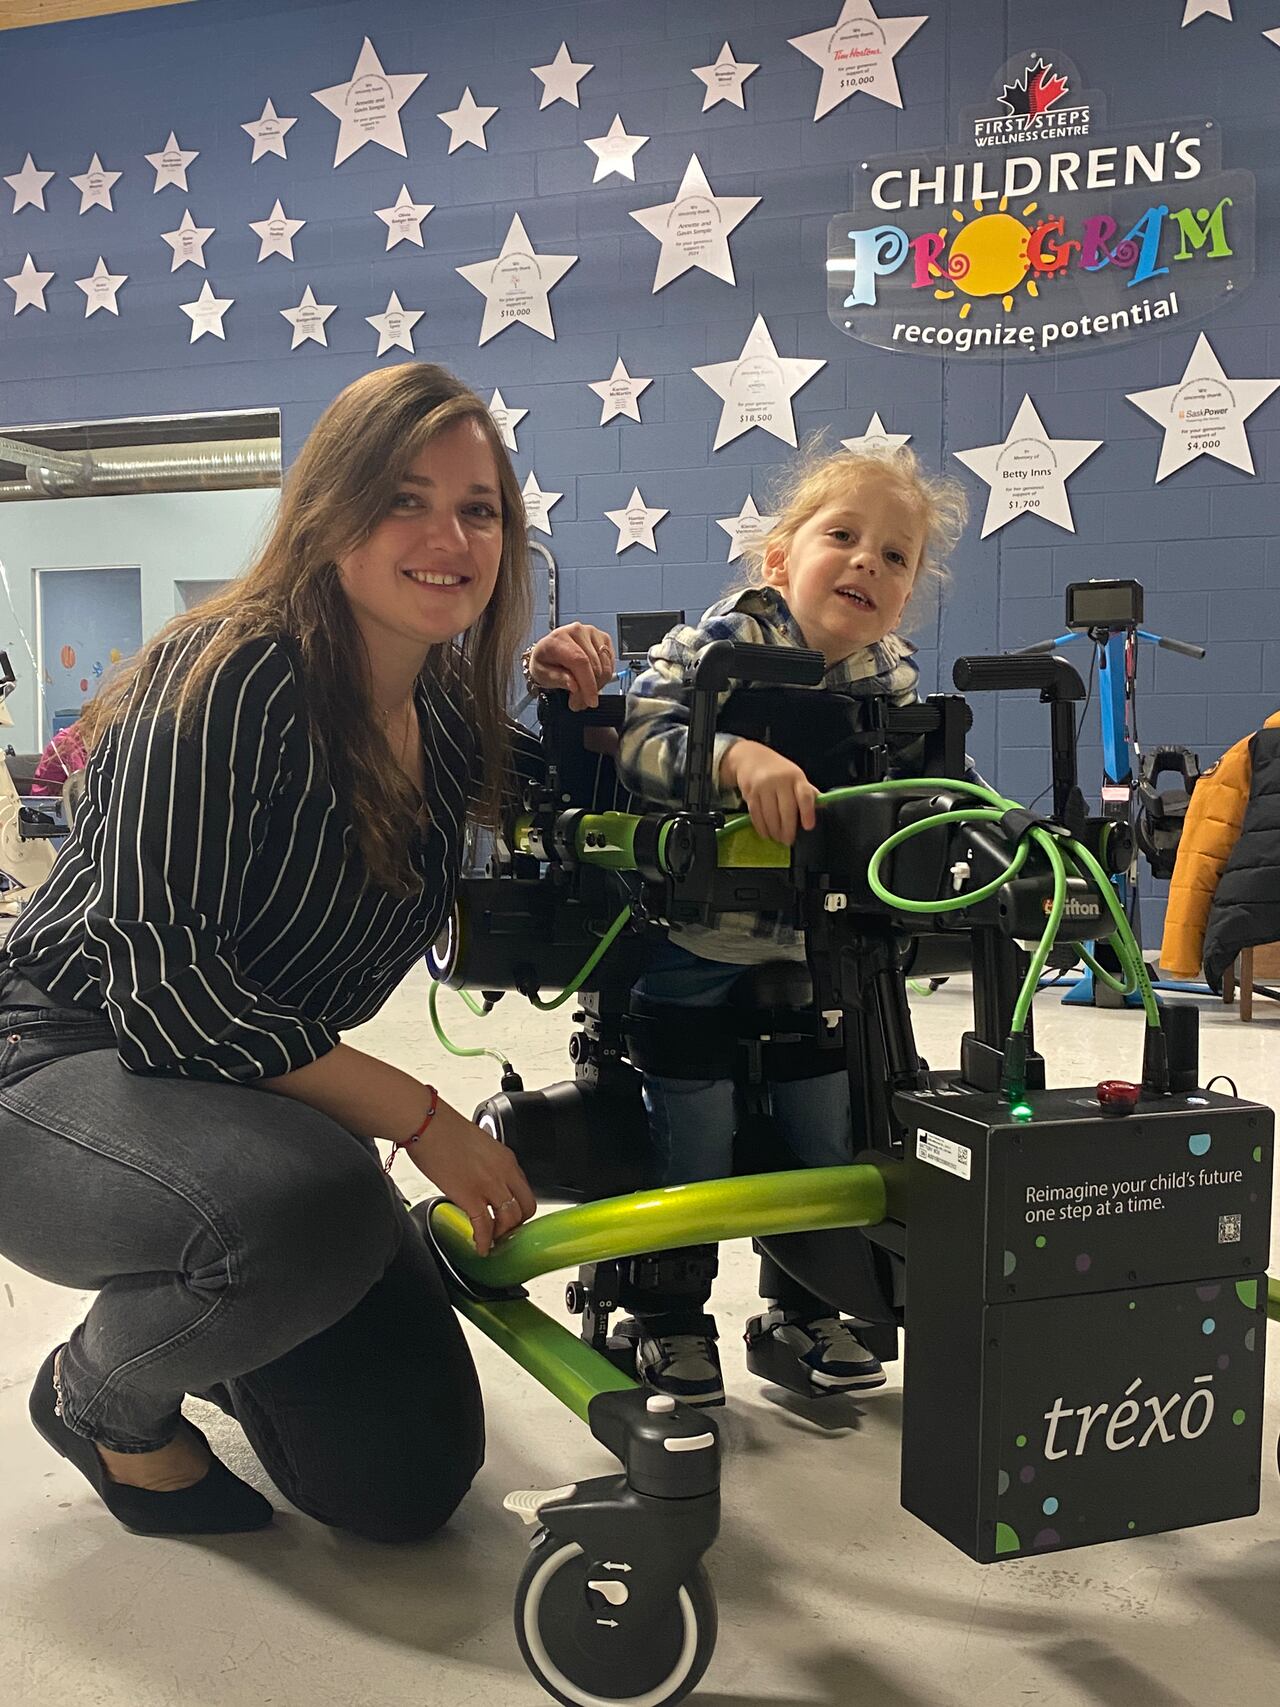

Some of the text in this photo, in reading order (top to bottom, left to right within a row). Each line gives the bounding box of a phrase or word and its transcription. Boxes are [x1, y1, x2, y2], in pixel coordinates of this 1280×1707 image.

[834, 48, 881, 60] Tim Hortons
[840, 76, 875, 88] $10,000
[975, 110, 1090, 136] FIRST STEPS
[975, 124, 1089, 147] WELLNESS CENTRE
[871, 131, 1201, 210] CHILDREN'S
[500, 308, 531, 318] $10,000
[893, 292, 1178, 352] recognize potential
[740, 414, 773, 423] $18,500
[1186, 408, 1228, 418] SaskPower
[1187, 440, 1221, 451] $4,000
[1002, 468, 1052, 480] Betty Inns
[1008, 500, 1041, 510] $1,700
[1063, 897, 1100, 915] ifton
[1026, 1168, 1243, 1204] Reimagine your child's future
[1025, 1196, 1166, 1223] one step at a time.
[1044, 1374, 1215, 1461] tréxō
